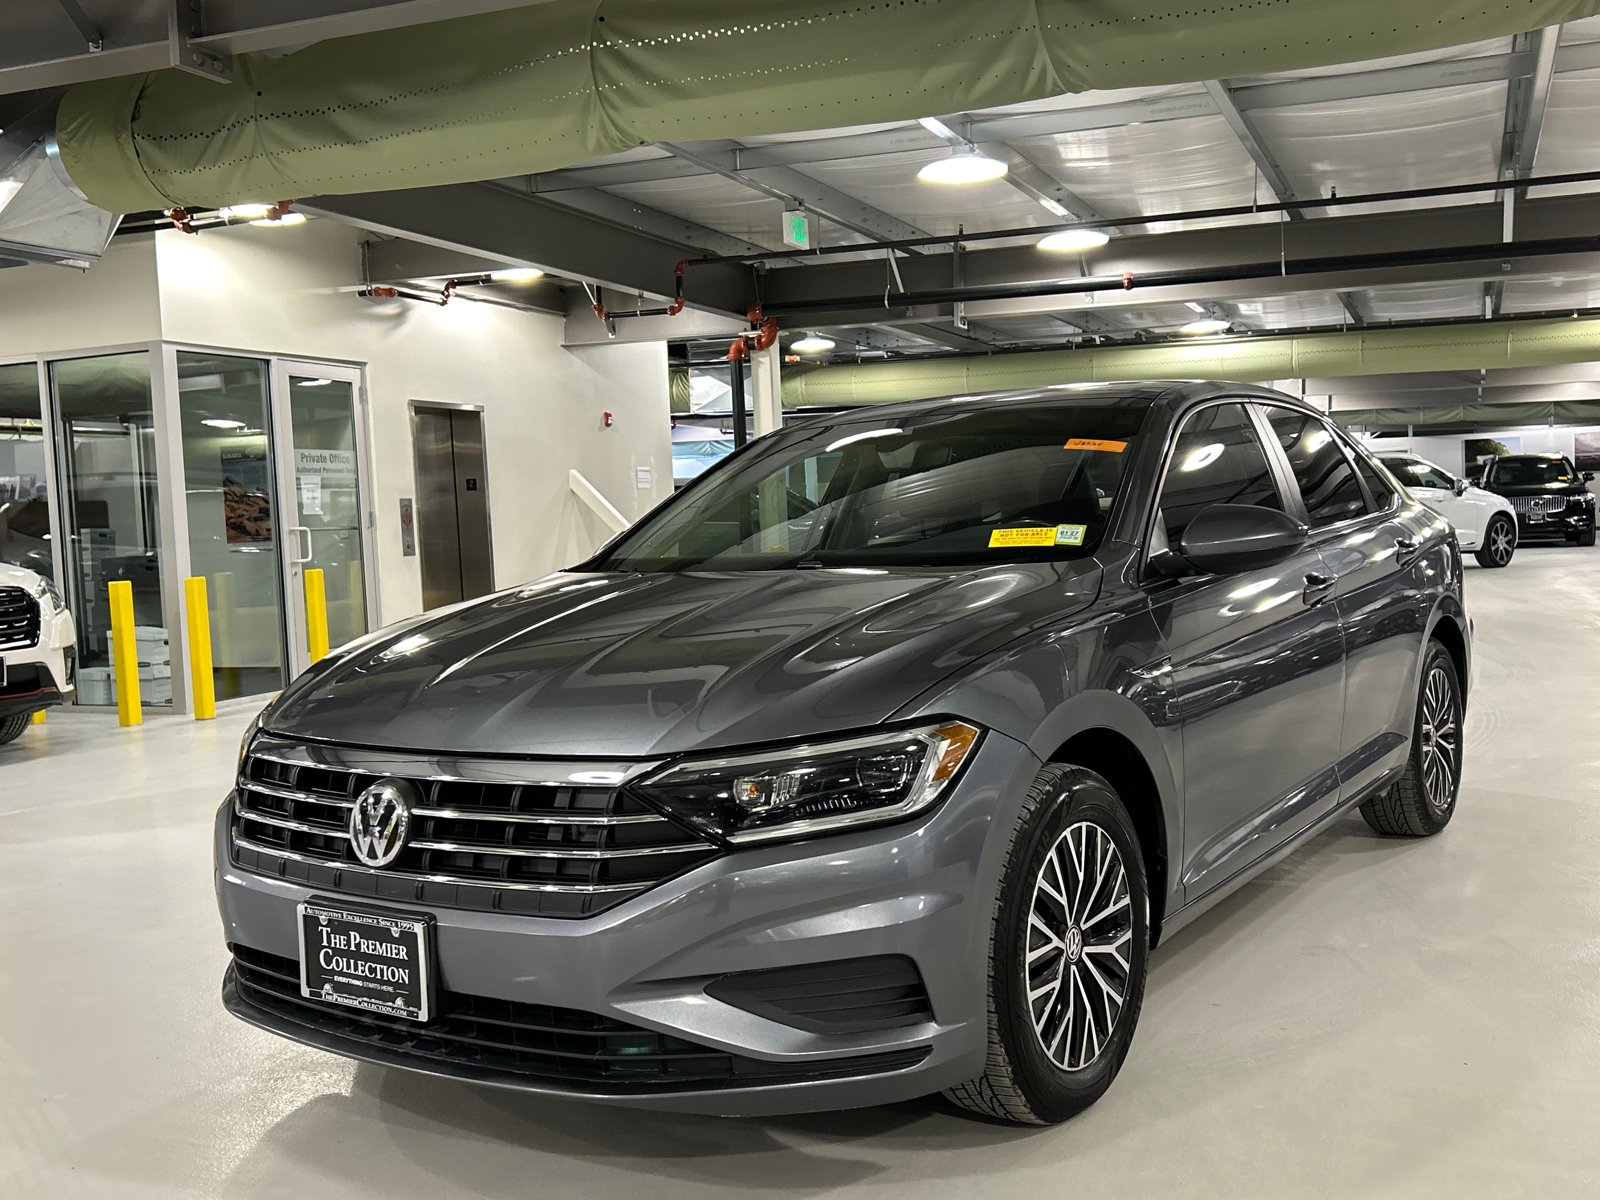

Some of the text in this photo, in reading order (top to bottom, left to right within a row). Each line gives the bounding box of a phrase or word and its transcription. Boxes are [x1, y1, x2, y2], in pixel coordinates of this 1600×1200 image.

[300, 452, 351, 464] Private Office
[296, 466, 322, 474] Authorized
[397, 921, 415, 931] 1995
[318, 926, 409, 961] THE PREMIER
[319, 948, 410, 985] COLLECTION
[333, 975, 363, 987] EVERYTHING
[363, 981, 381, 990] STARTS
